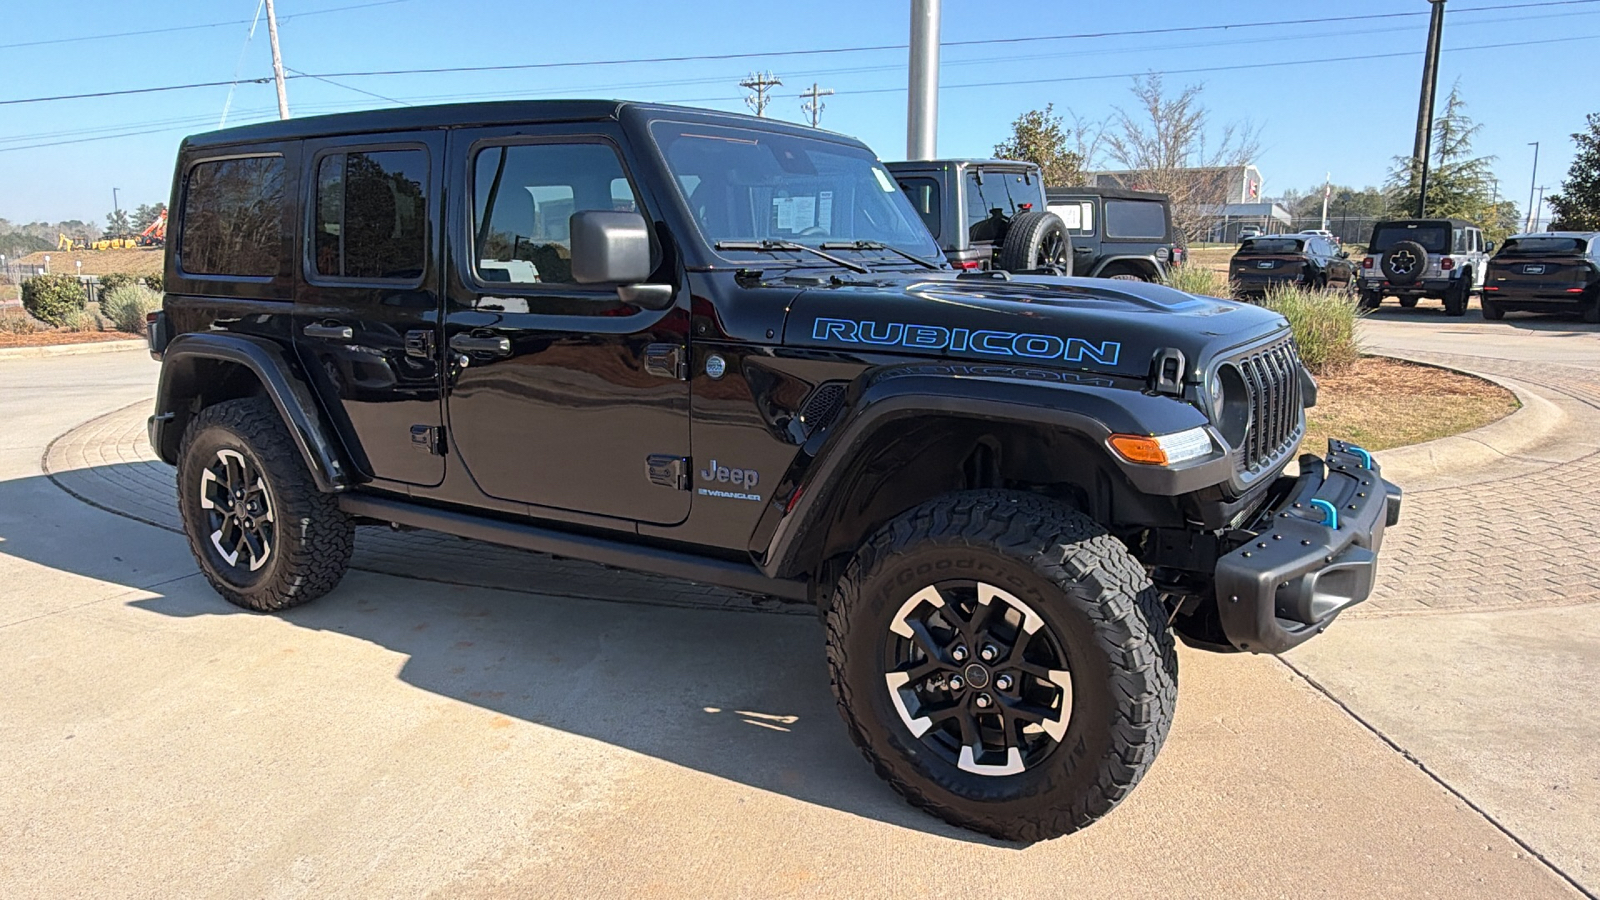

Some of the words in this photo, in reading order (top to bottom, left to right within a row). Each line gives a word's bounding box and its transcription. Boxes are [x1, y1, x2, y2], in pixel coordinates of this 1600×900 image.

[812, 317, 1121, 366] RUBICON
[700, 459, 760, 490] Jeep
[707, 489, 761, 501] WRANGLER
